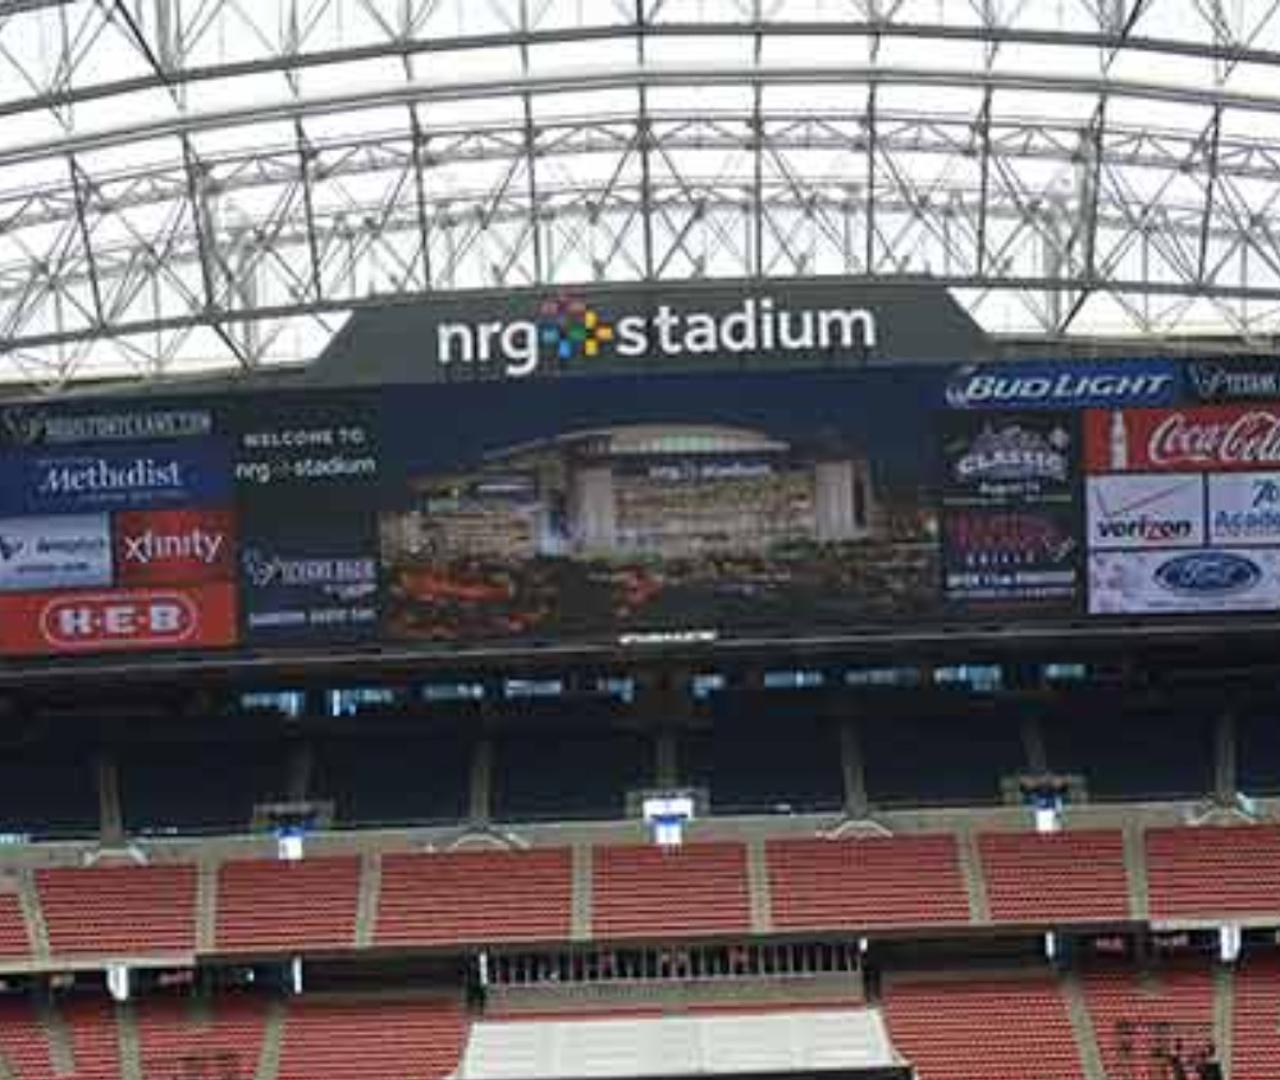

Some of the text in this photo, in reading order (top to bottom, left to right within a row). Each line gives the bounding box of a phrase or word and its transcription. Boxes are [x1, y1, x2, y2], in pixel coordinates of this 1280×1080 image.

[438, 298, 876, 375] nrg stadium
[967, 373, 1173, 399] BUD LIGHT
[38, 459, 184, 494] Methodist
[1096, 515, 1192, 540] verizon
[124, 527, 222, 564] xfinity
